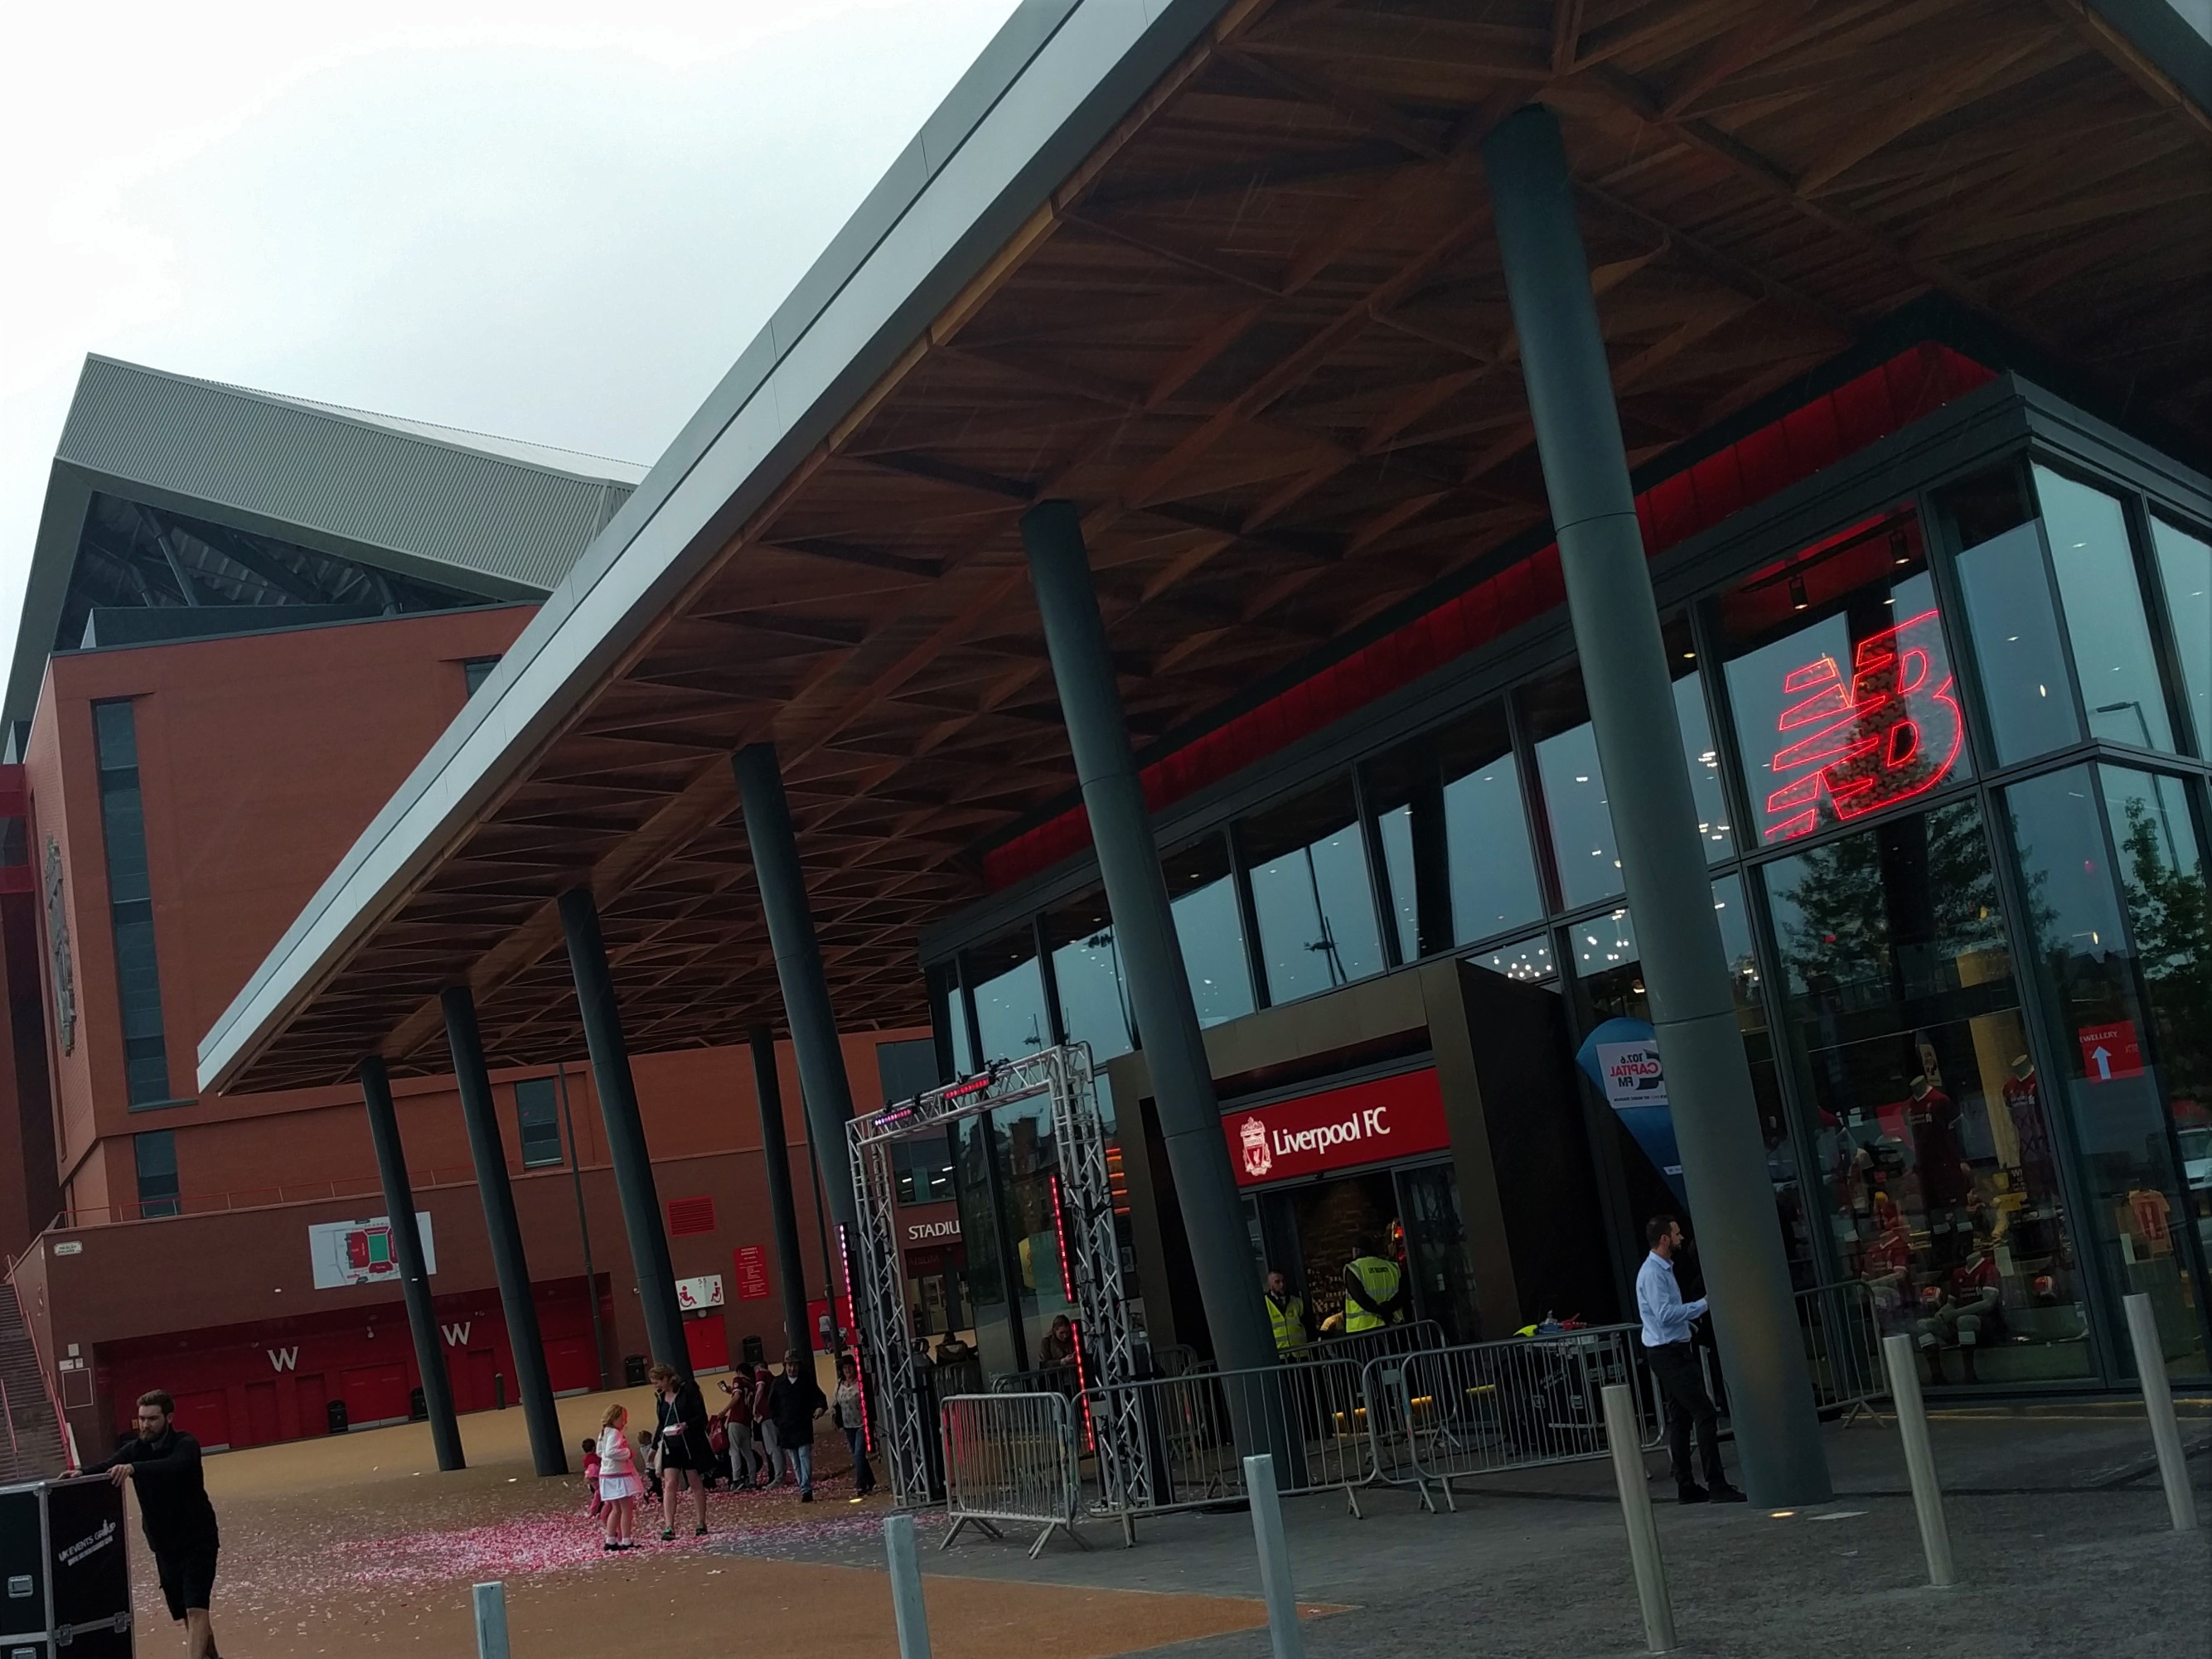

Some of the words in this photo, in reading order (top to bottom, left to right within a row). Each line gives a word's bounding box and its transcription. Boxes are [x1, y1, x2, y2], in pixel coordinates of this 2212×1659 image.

[1272, 1112, 1362, 1156] Liverpool
[1363, 1106, 1392, 1138] FC
[441, 1321, 471, 1347] W
[267, 1346, 298, 1372] W
